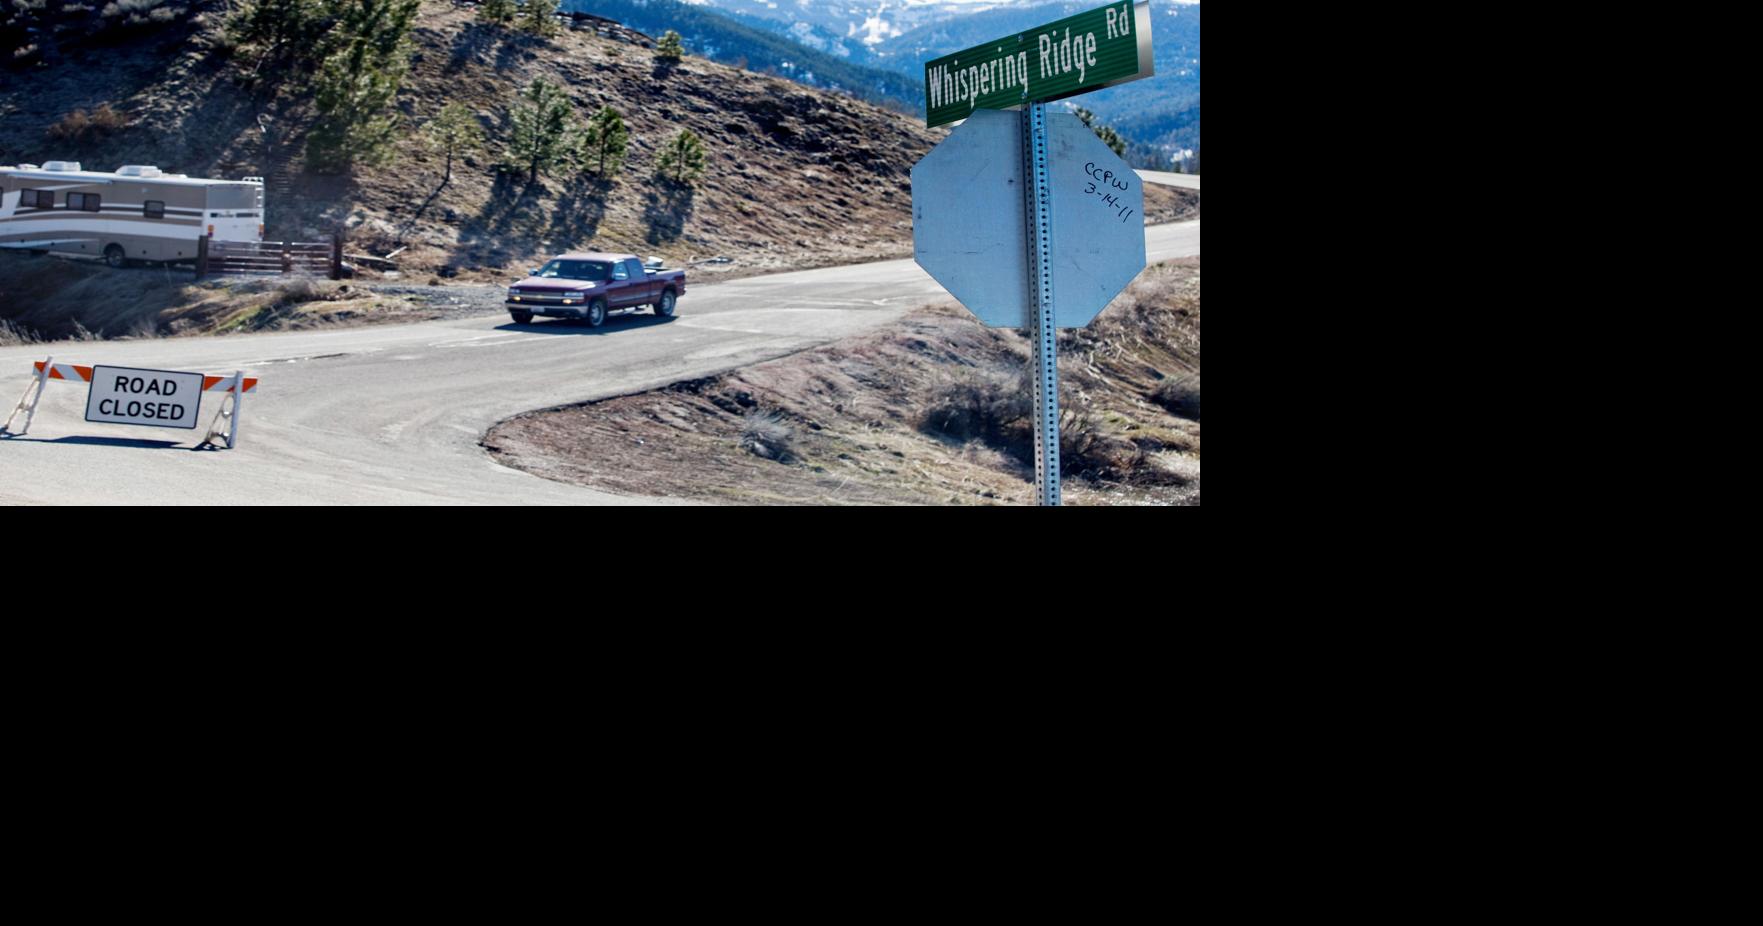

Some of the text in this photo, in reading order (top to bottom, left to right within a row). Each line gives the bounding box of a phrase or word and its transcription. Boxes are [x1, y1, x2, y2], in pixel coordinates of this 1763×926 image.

[928, 5, 1130, 109] Whispering Ridge Rd
[1084, 162, 1129, 191] CCPW
[1084, 182, 1134, 223] 3-14-11
[114, 376, 177, 396] ROAD
[99, 399, 185, 420] CLOSED
